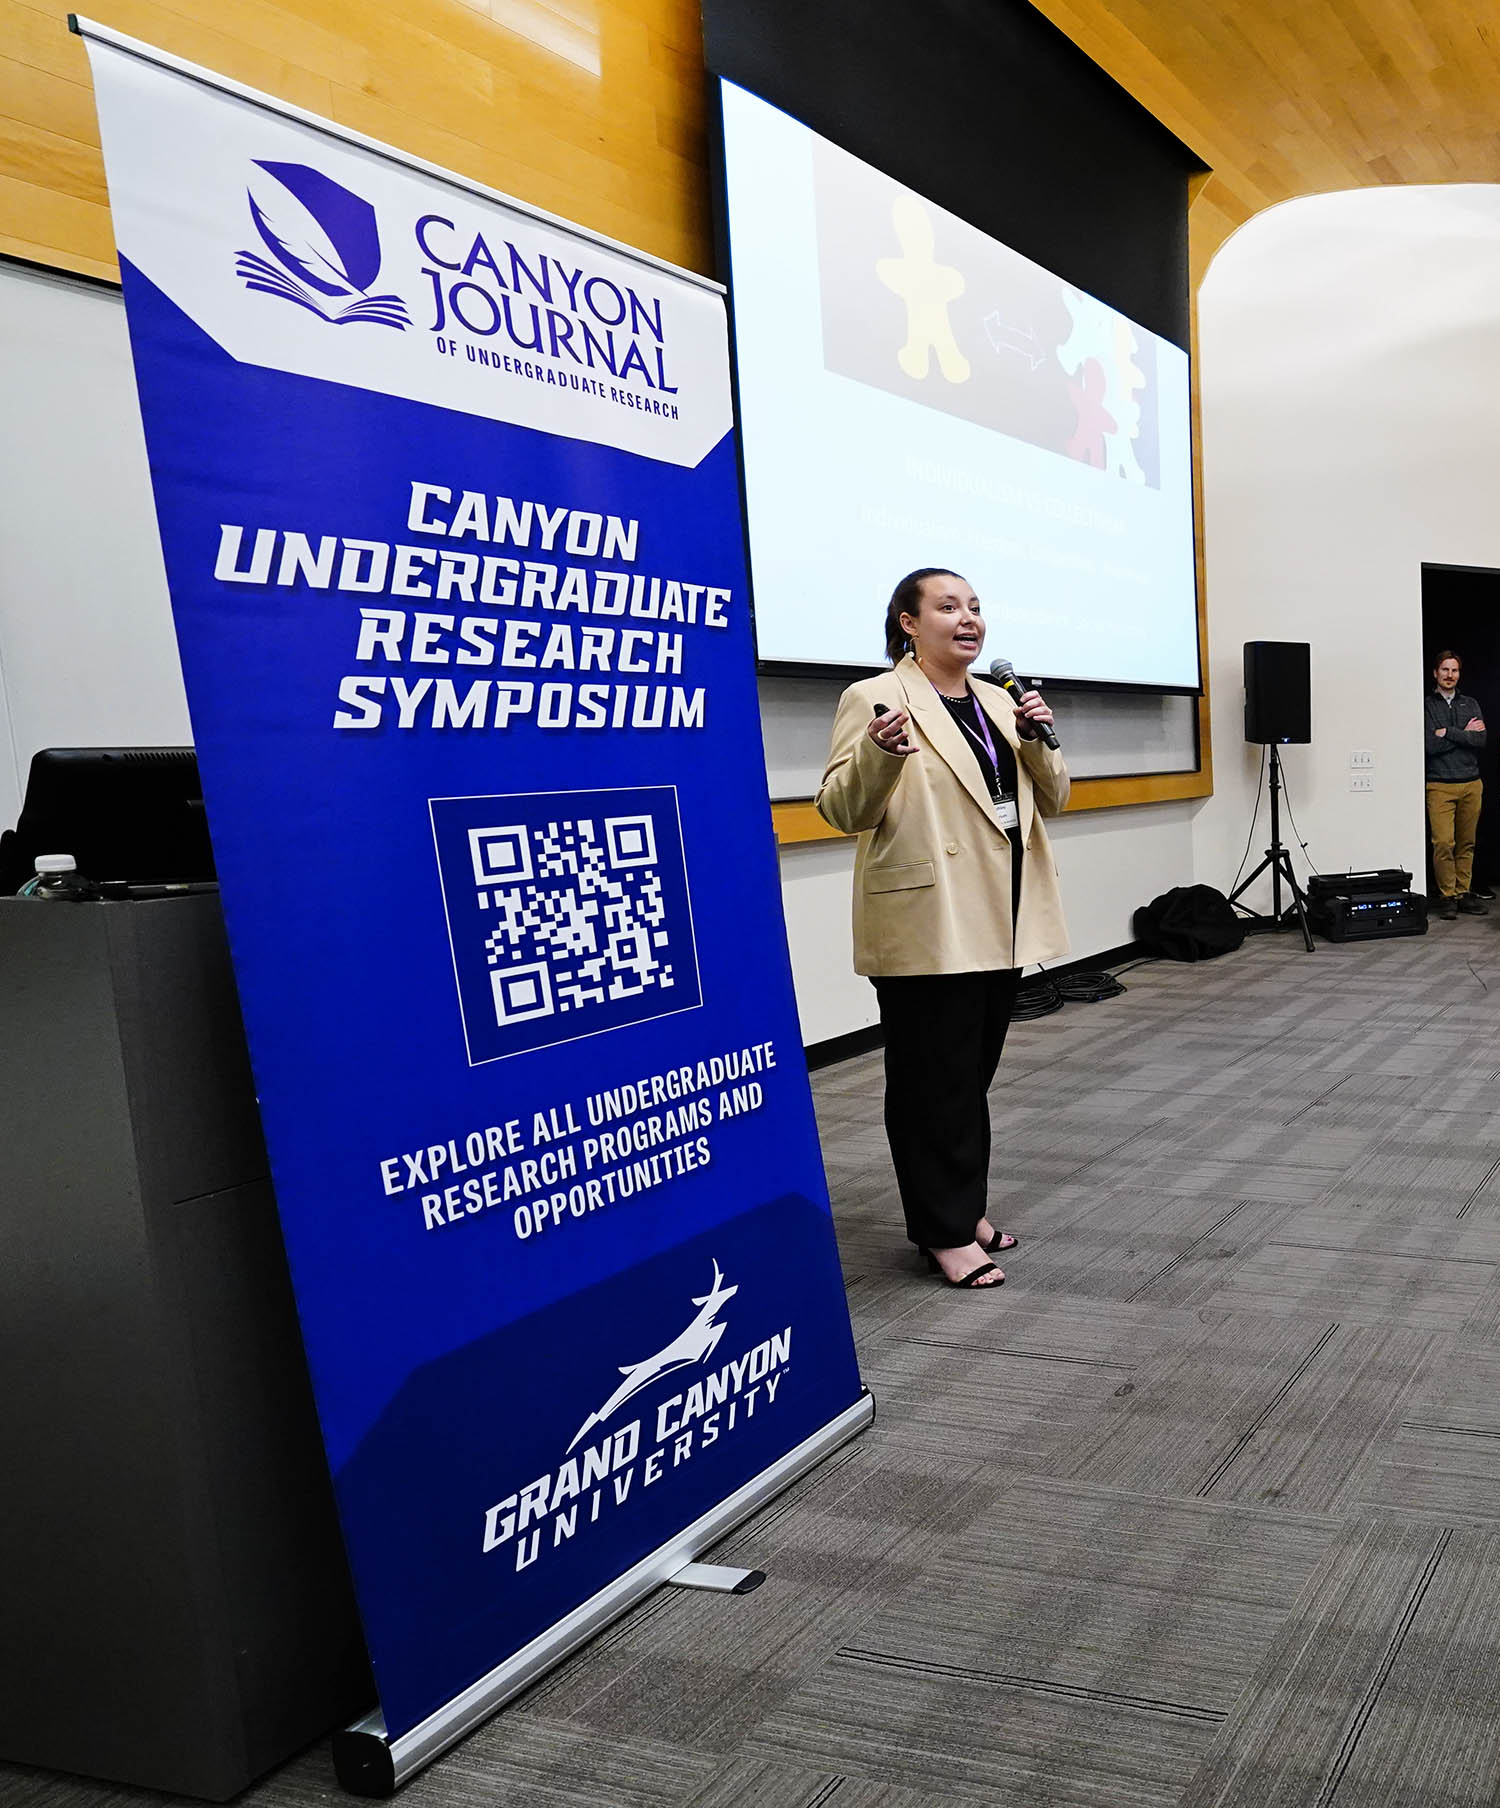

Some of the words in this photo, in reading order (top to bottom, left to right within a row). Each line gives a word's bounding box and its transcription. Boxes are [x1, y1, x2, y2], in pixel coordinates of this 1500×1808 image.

[415, 214, 664, 344] CANYON
[421, 267, 679, 395] JOURNAL
[436, 336, 457, 356] OF
[466, 344, 606, 398] UNDERGRADUATE
[610, 386, 679, 420] RESEARCH
[213, 524, 732, 628] UNDERGRADUATE
[407, 481, 640, 562] CANYON
[355, 607, 683, 675] RESEARCH
[332, 675, 706, 729] SYMPOSIUM
[379, 1119, 525, 1196] EXPLORE
[533, 1103, 582, 1147] ALL
[586, 1040, 777, 1127] UNDERGRADUATE
[421, 1145, 577, 1231] RESEARCH
[582, 1097, 713, 1170] PROGRAMS
[718, 1082, 764, 1121] AND
[513, 1136, 711, 1240] OPPORTUNITIES
[482, 1419, 641, 1553] GRAND
[655, 1326, 792, 1443] CANYON
[515, 1372, 781, 1572] UNIVERSITY
